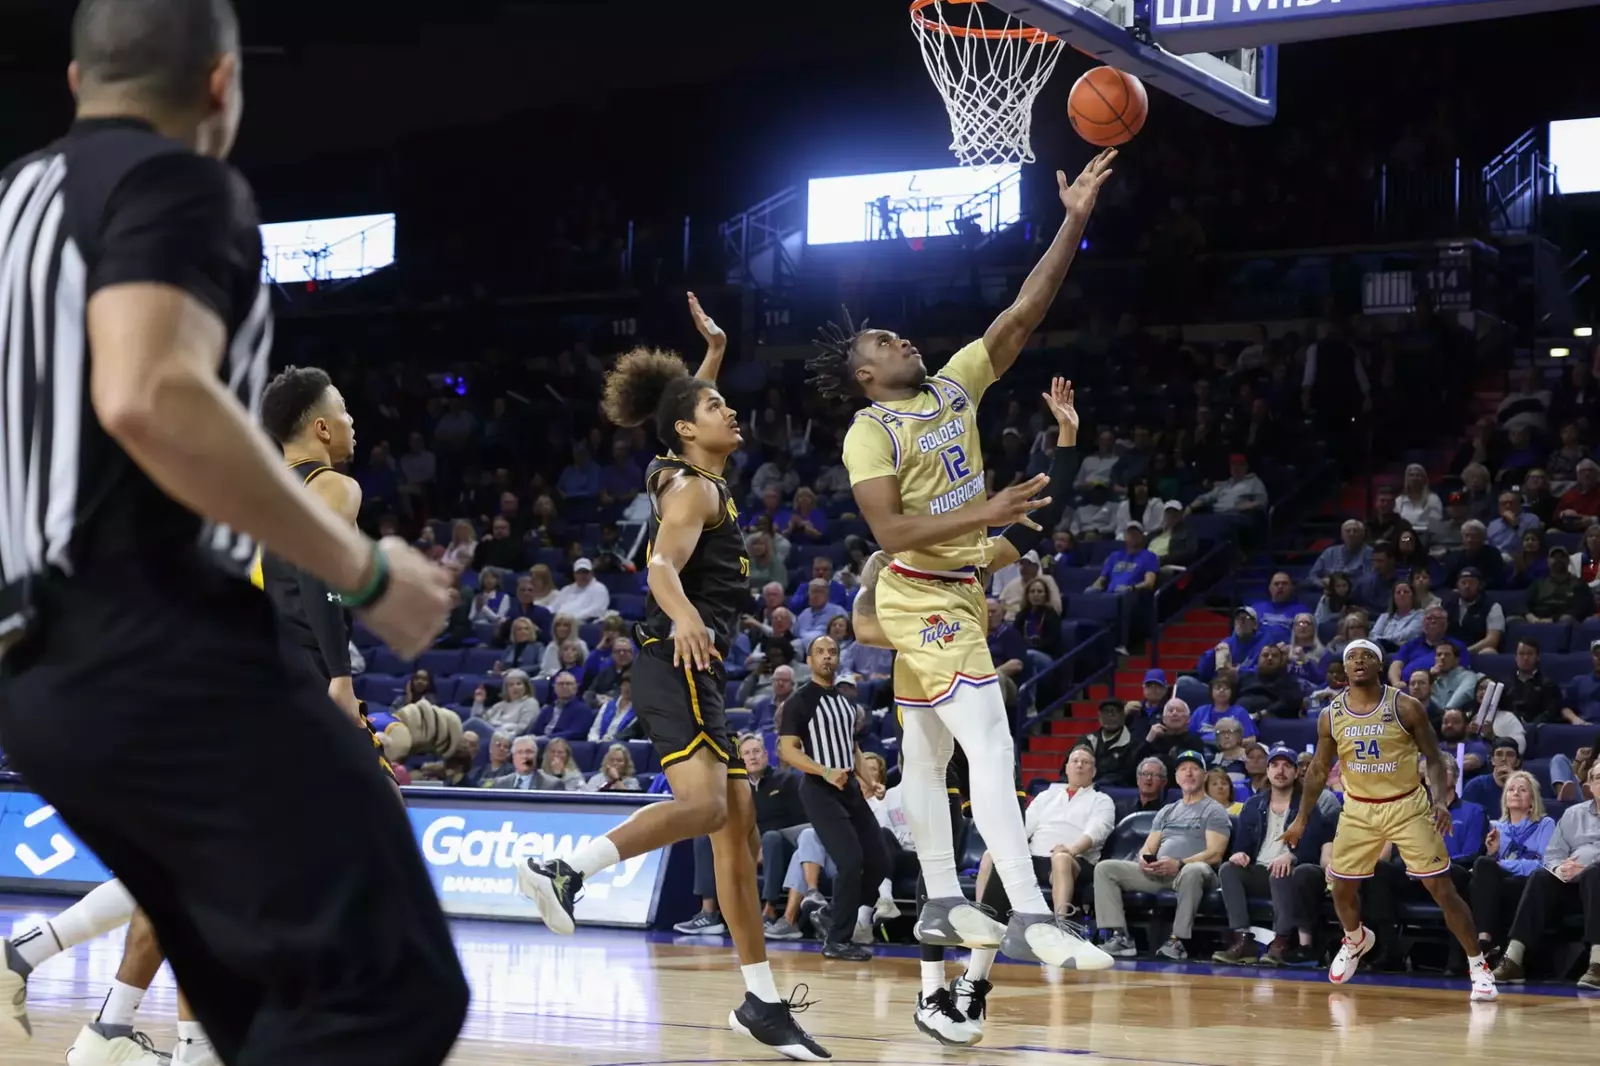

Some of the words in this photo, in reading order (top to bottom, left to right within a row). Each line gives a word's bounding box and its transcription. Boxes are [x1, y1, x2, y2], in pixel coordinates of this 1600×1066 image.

[1427, 270, 1458, 289] 114
[612, 318, 637, 336] 113
[764, 310, 790, 326] 114
[918, 418, 965, 453] GOLDEN
[941, 445, 971, 482] 12
[929, 470, 985, 515] HURRICAN
[918, 621, 961, 647] Tulsa
[1344, 724, 1385, 737] GOLDEN
[1354, 740, 1380, 760] 24
[1346, 761, 1398, 773] HURRICANE
[422, 816, 649, 887] Gatewy
